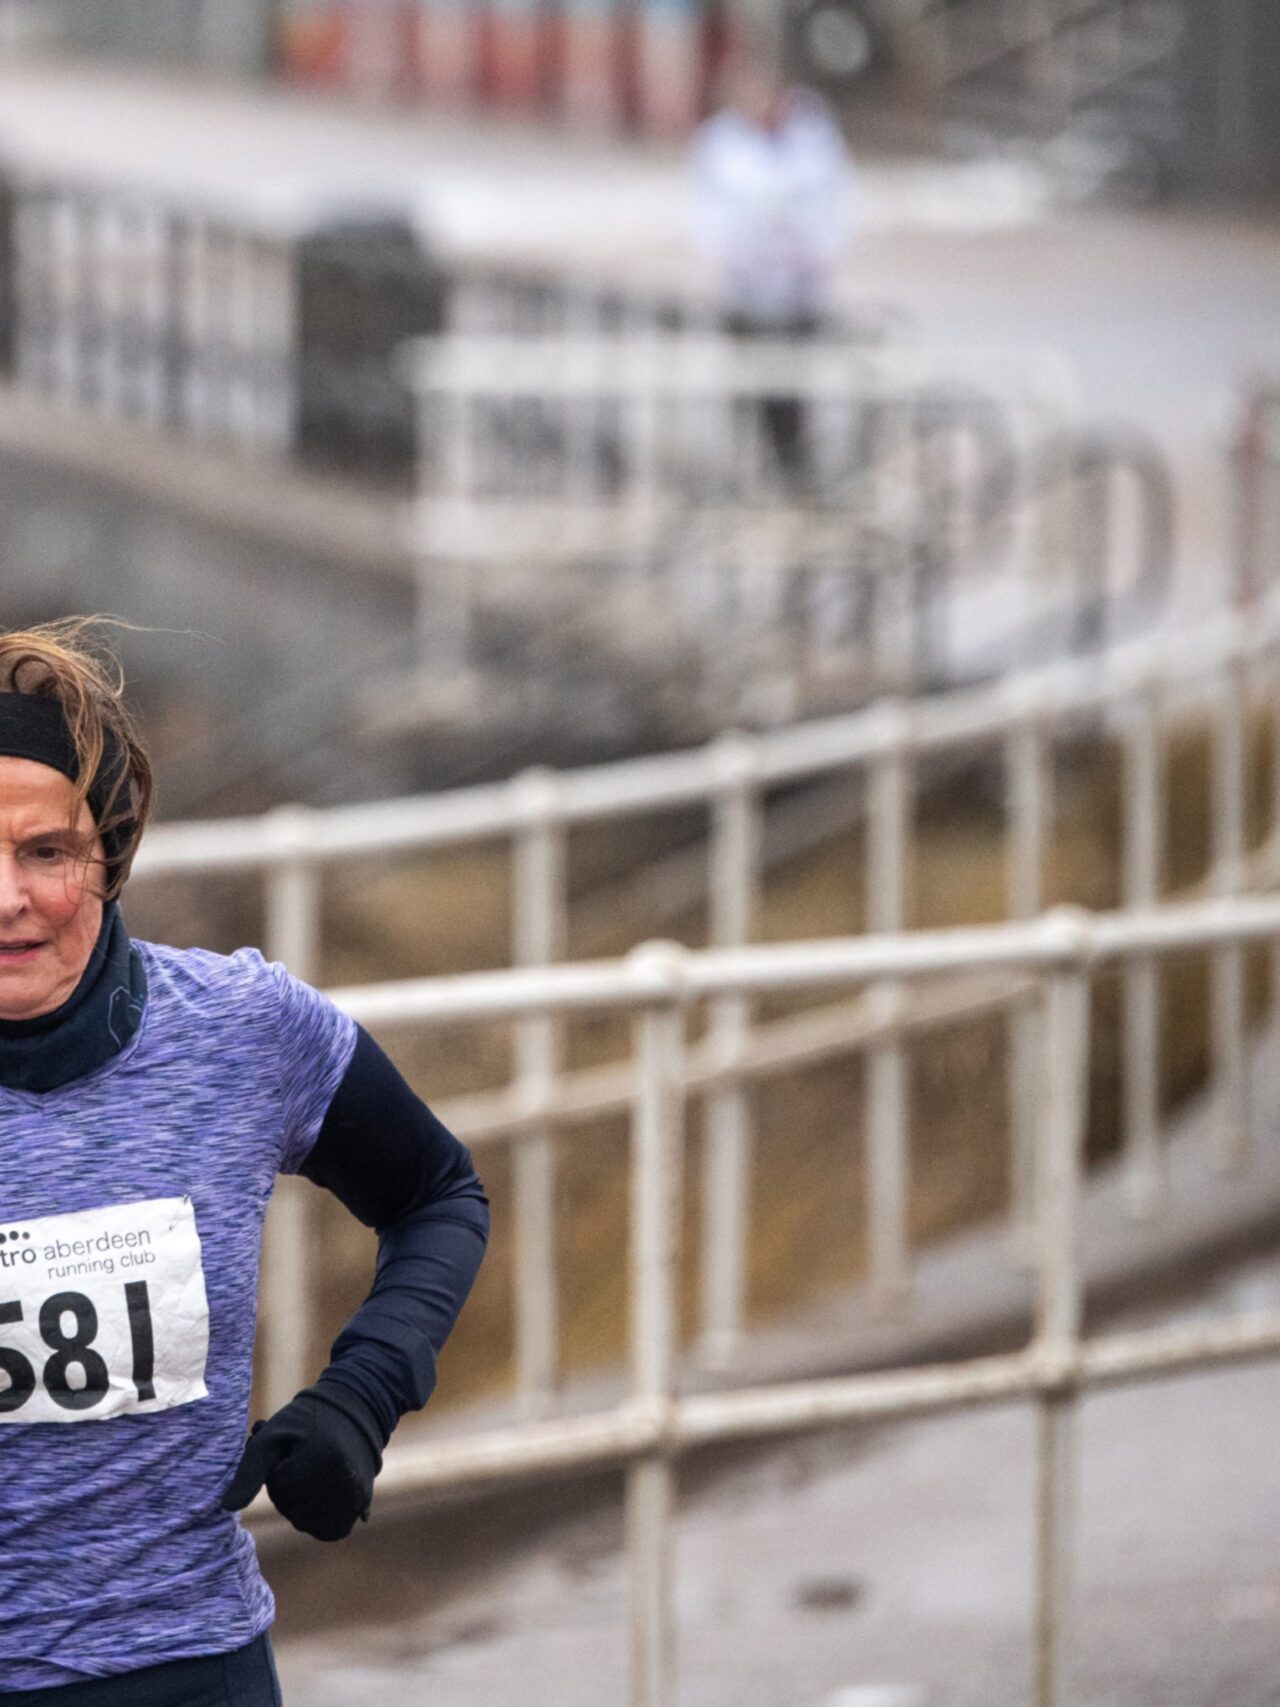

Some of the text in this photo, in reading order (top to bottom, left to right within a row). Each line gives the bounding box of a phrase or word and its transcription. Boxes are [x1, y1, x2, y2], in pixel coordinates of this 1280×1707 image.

[44, 1230, 151, 1260] aberdeen
[48, 1251, 156, 1279] running club
